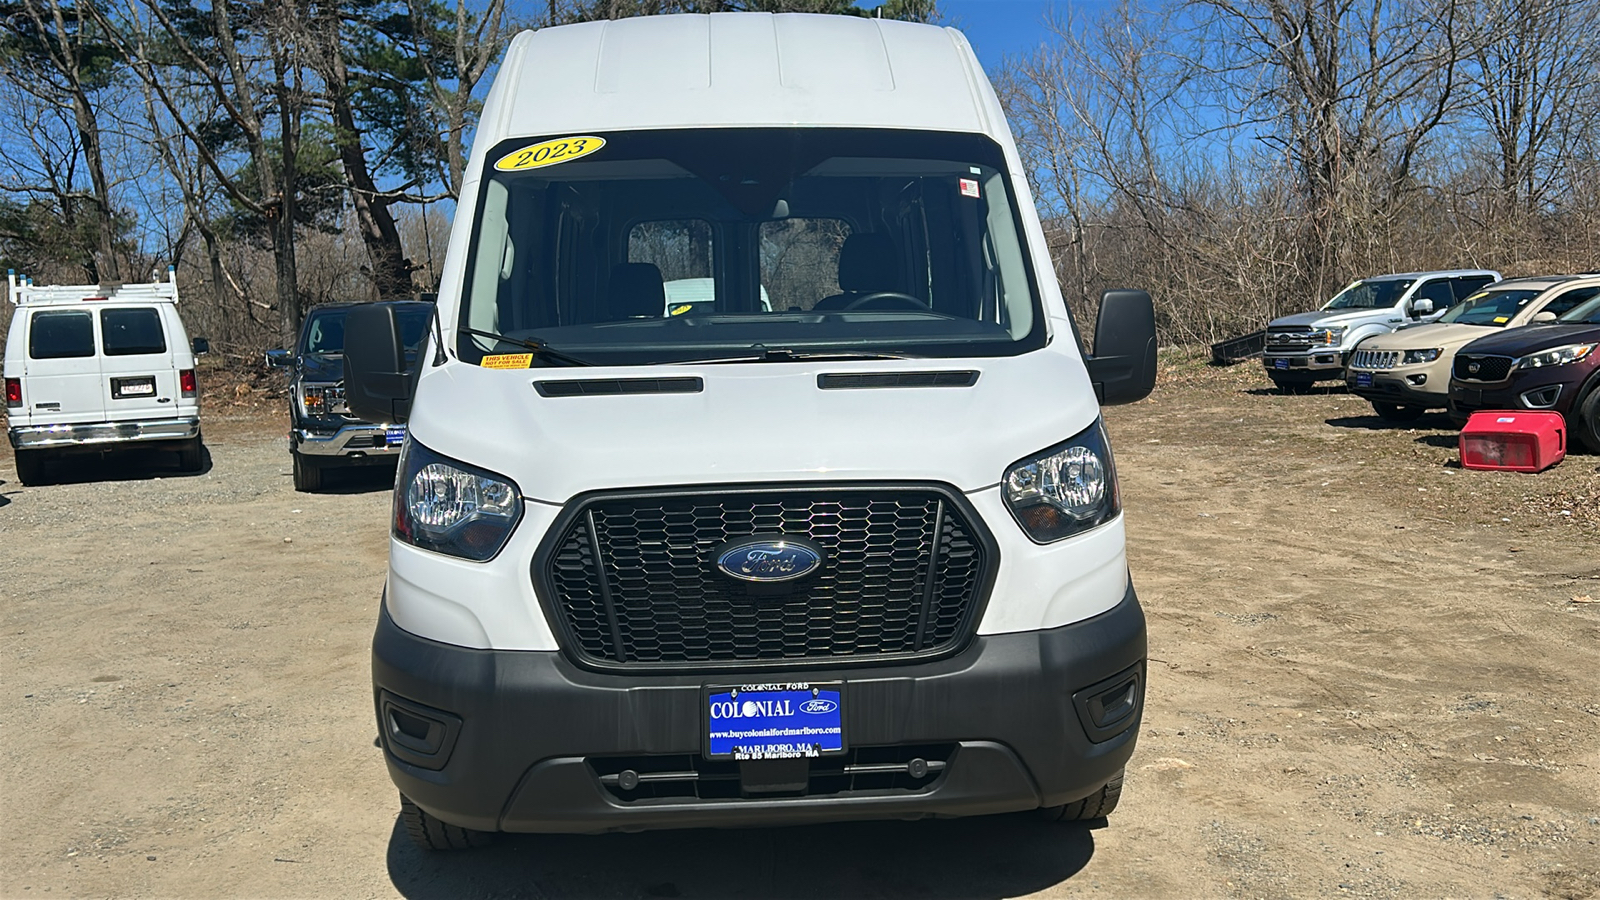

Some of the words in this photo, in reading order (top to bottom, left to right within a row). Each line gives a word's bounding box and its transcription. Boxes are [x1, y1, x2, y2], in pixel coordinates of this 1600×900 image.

[514, 140, 588, 168] 2023
[741, 550, 797, 573] Ford
[741, 683, 783, 692] COLONIAL
[786, 682, 809, 690] FORD
[710, 700, 795, 719] COLONIAL
[806, 702, 830, 711] Ford
[710, 727, 841, 739] www.buycolonialfordmarlboro.com
[796, 742, 813, 752] MA
[735, 752, 750, 760] Rte
[764, 751, 801, 759] Marlboro
[805, 749, 819, 758] MA
